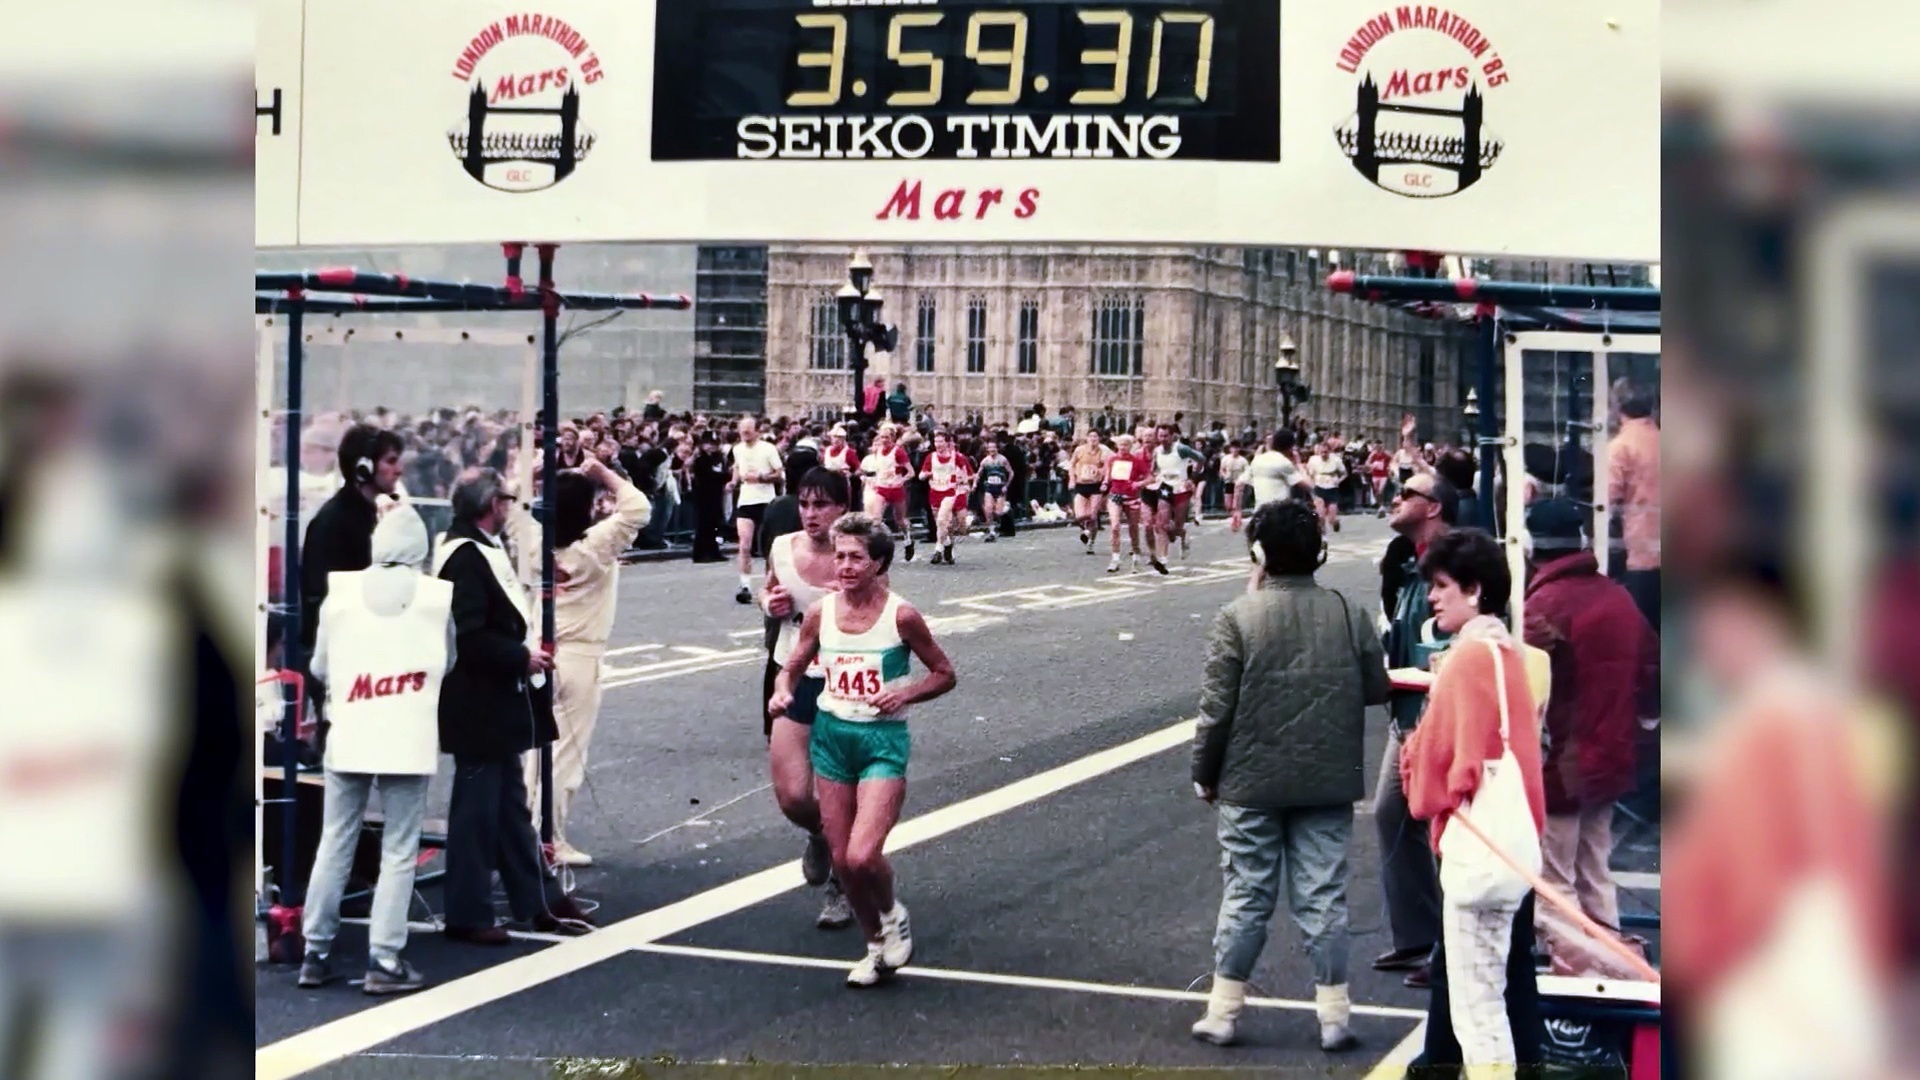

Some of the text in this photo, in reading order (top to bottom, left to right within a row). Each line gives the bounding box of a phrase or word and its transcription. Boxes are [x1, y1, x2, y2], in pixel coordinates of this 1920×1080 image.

[452, 22, 504, 82] LONDON
[506, 13, 588, 59] MARATHON
[1336, 12, 1394, 74] LONDON
[1396, 5, 1490, 59] MARATHON
[489, 66, 568, 104] Mars
[1382, 65, 1469, 100] Mars
[737, 115, 1182, 159] SEIKO TIMING
[1404, 173, 1432, 188] GLC
[876, 180, 1041, 221] Mars
[834, 655, 865, 666] Mars
[347, 671, 427, 702] Mars
